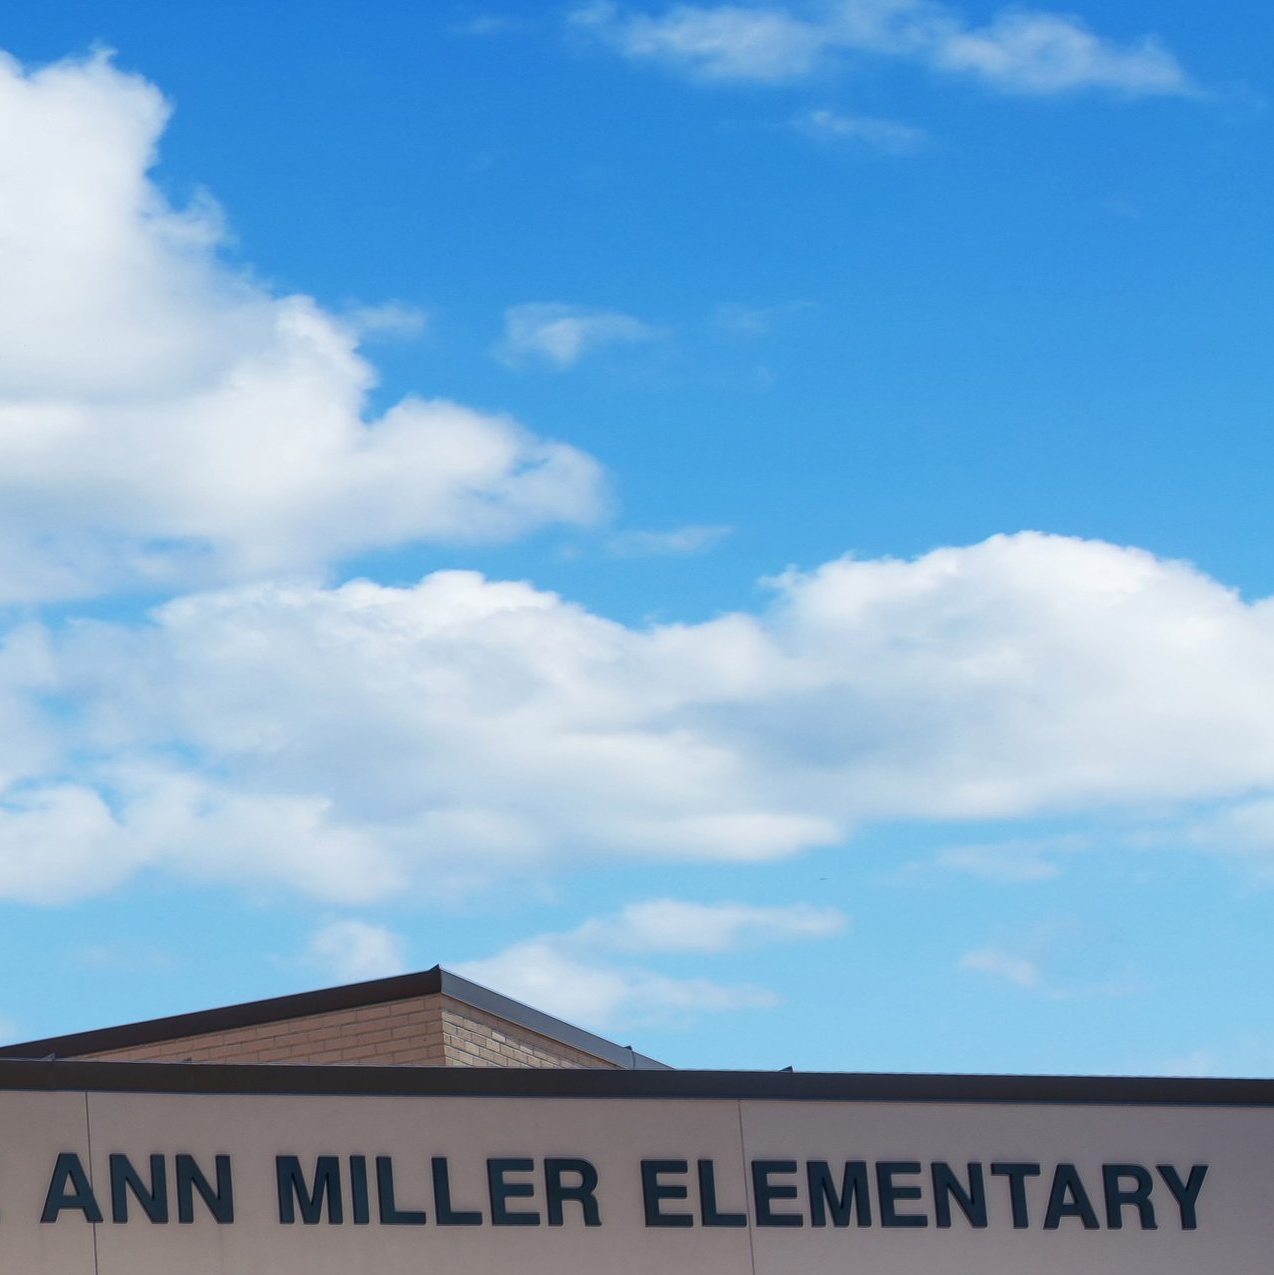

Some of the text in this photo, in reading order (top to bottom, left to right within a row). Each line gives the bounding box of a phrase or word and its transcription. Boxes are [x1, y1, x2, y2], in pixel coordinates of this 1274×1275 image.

[37, 1151, 235, 1225] ANN
[274, 1154, 603, 1228] MILLER
[639, 1157, 1211, 1232] ELEMENTARY
